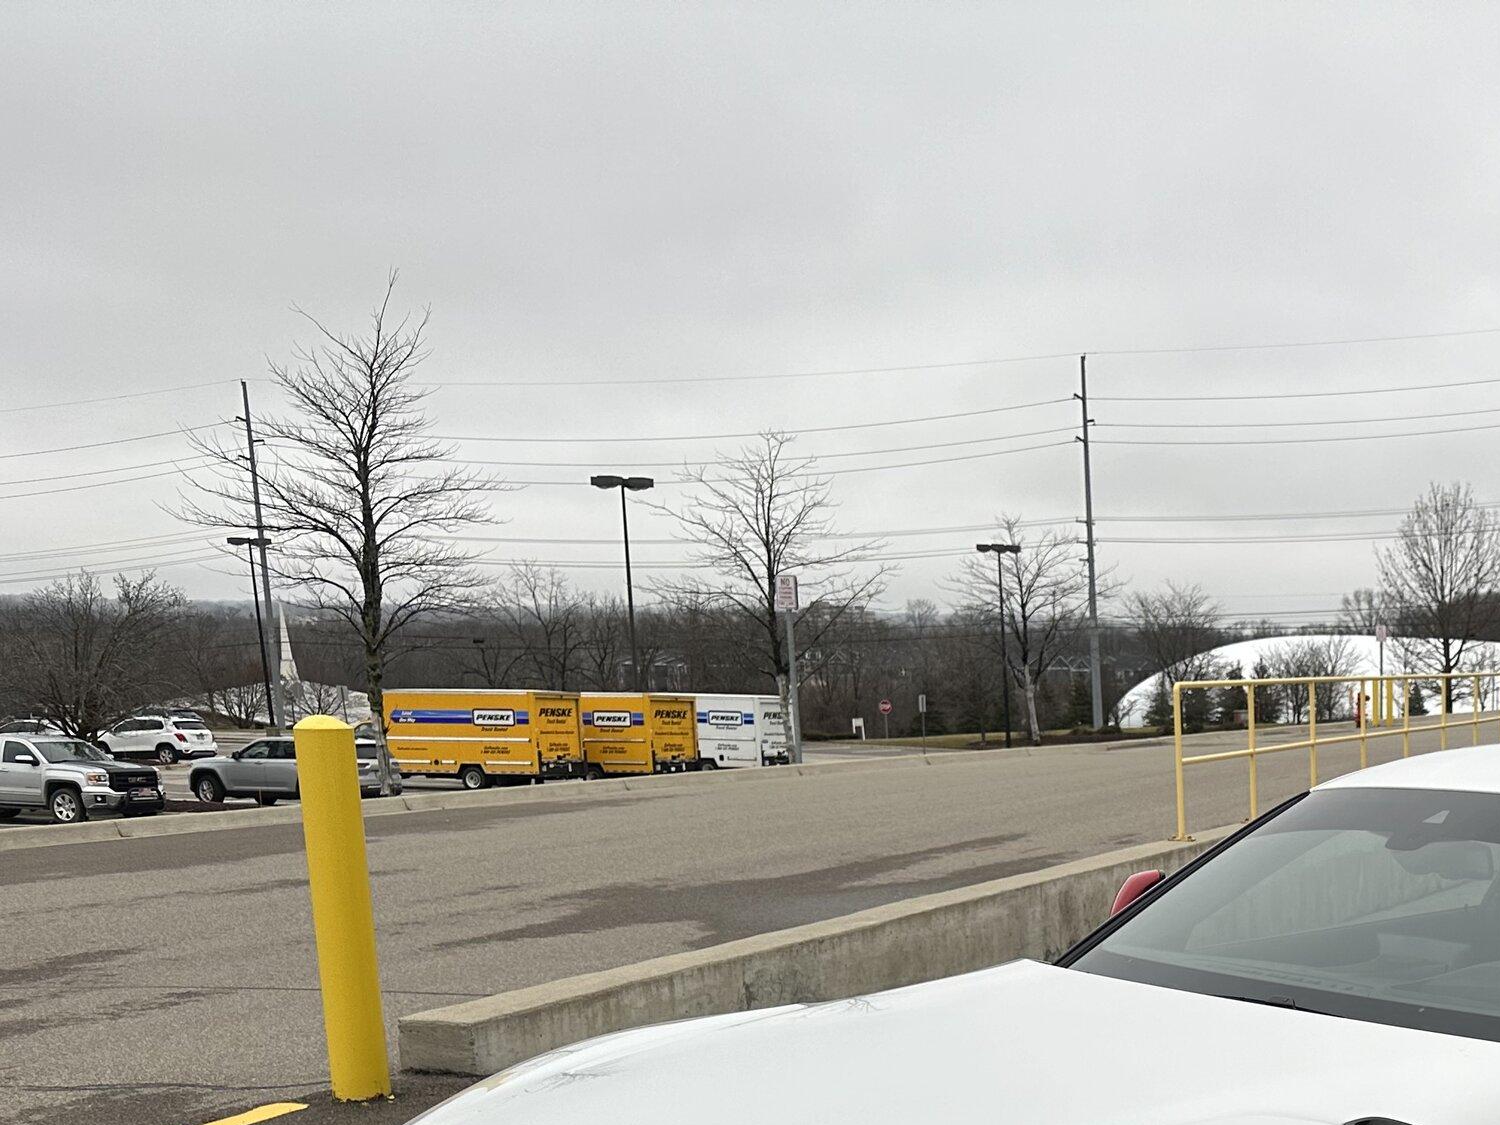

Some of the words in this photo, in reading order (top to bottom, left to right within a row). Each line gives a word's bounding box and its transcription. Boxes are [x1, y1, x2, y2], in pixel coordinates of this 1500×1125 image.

[538, 707, 573, 717] PENSKE
[654, 709, 688, 719] PENSKE
[476, 713, 512, 721] PENSKE
[595, 715, 628, 723] PENSKE
